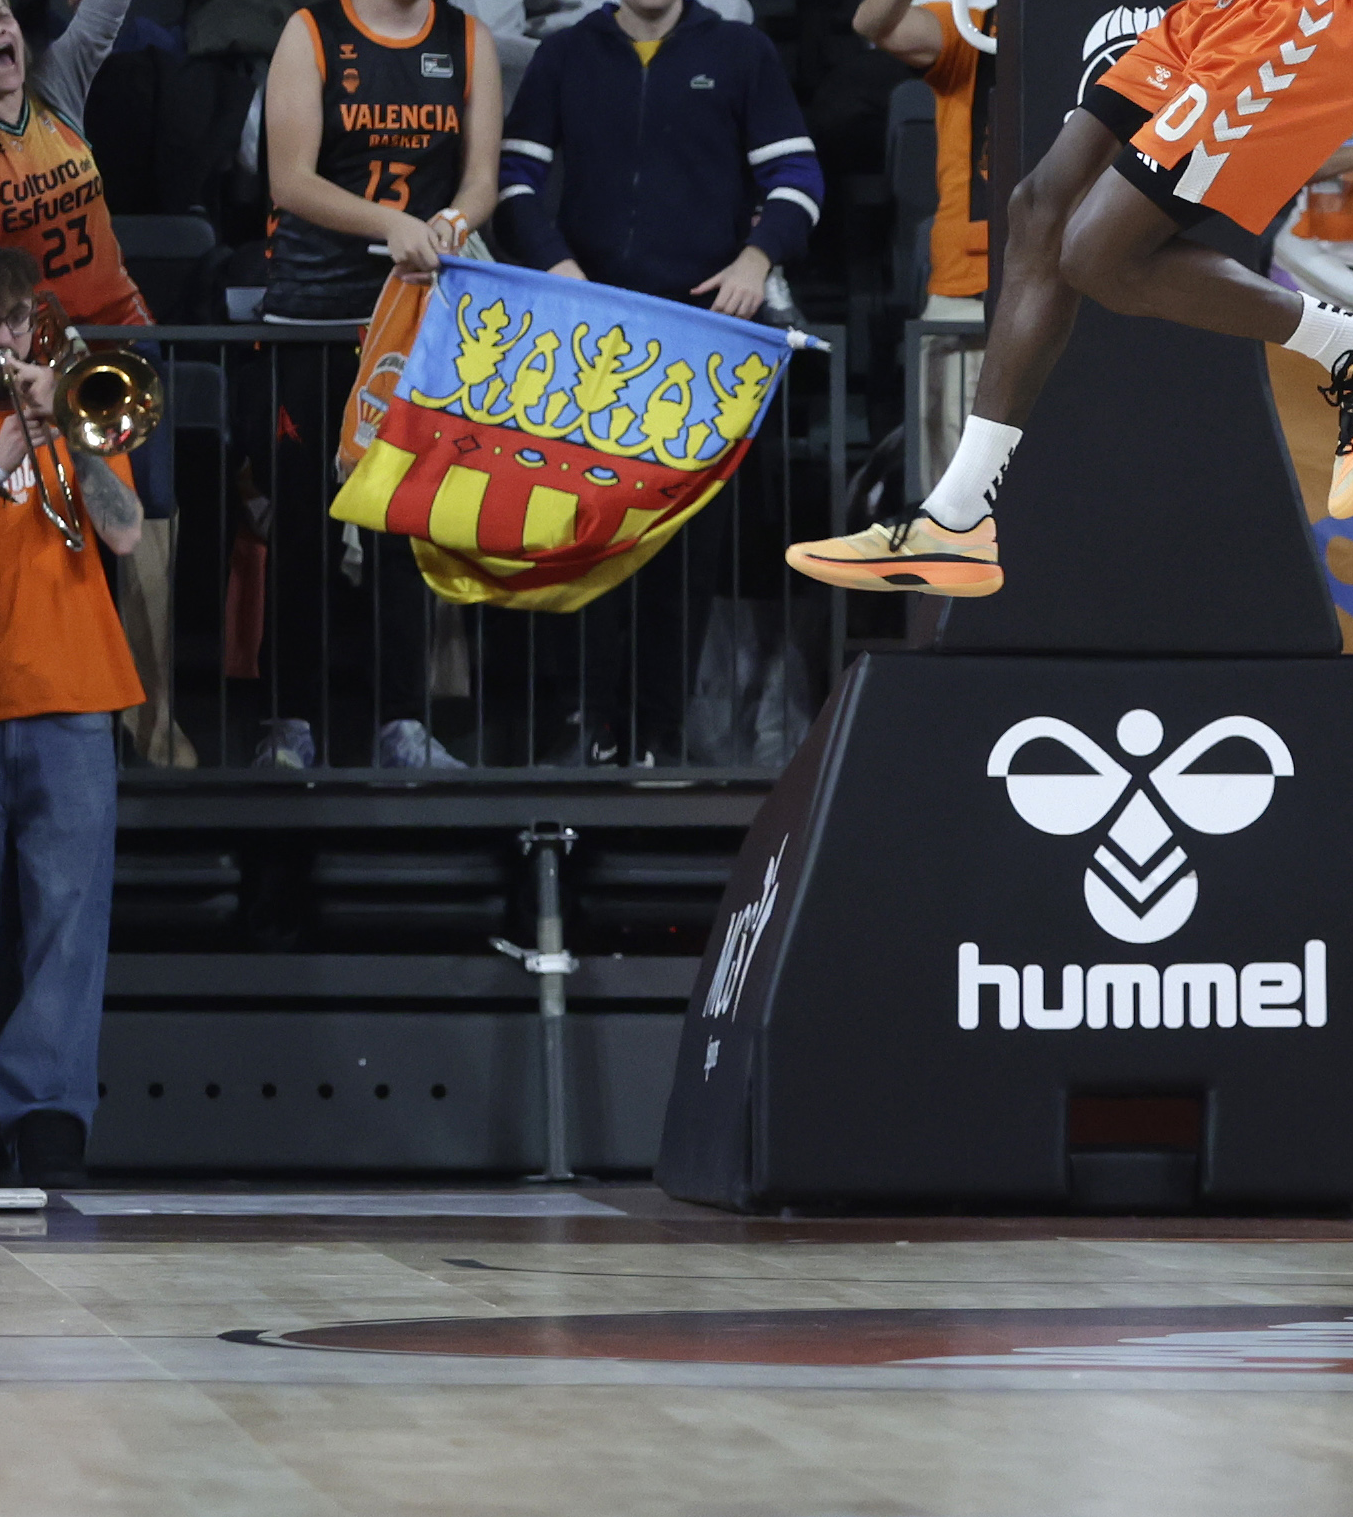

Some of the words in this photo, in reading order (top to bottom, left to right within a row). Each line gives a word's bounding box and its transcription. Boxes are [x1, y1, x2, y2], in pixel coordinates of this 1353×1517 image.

[339, 104, 461, 134] VALENCIA
[1155, 83, 1208, 142] 0
[368, 134, 431, 149] BASKET
[0, 159, 80, 206] Cultura
[2, 176, 103, 233] Esfuerzo
[364, 160, 417, 212] 13
[42, 215, 94, 279] 23
[958, 940, 1327, 1030] hummel
